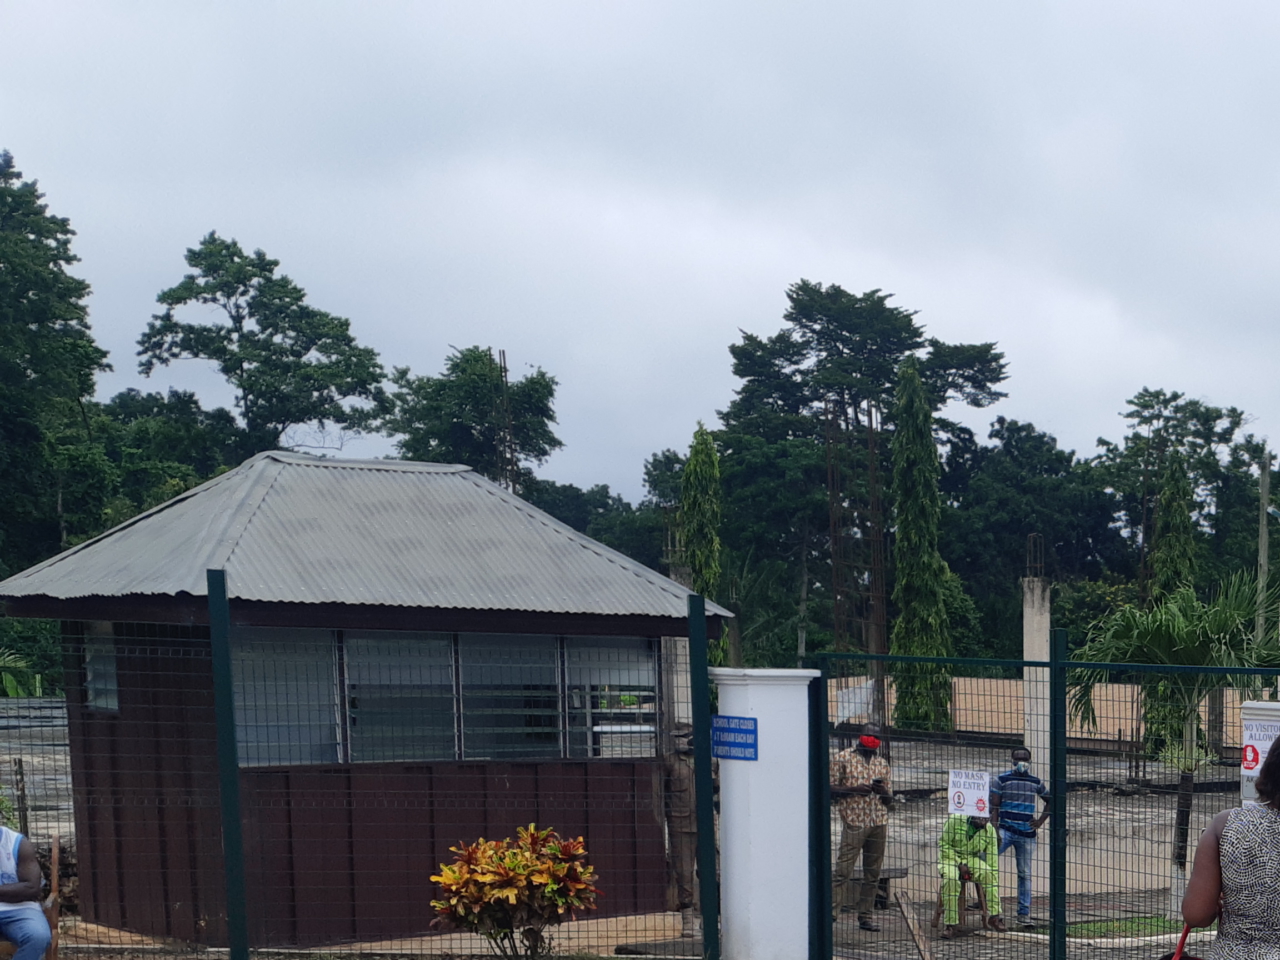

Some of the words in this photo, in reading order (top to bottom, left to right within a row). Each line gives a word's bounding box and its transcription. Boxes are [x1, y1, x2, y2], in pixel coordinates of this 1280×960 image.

[713, 718, 729, 728] SCHOOL
[729, 719, 739, 729] GATE
[1244, 723, 1253, 731] NO
[714, 731, 720, 741] AT
[735, 732, 746, 743] EACH
[746, 733, 755, 744] DAY
[1248, 733, 1278, 742] ALLOWE
[952, 770, 963, 779] NO
[964, 771, 984, 781] MASK
[951, 780, 961, 788] NO
[963, 781, 986, 791] ENTRY
